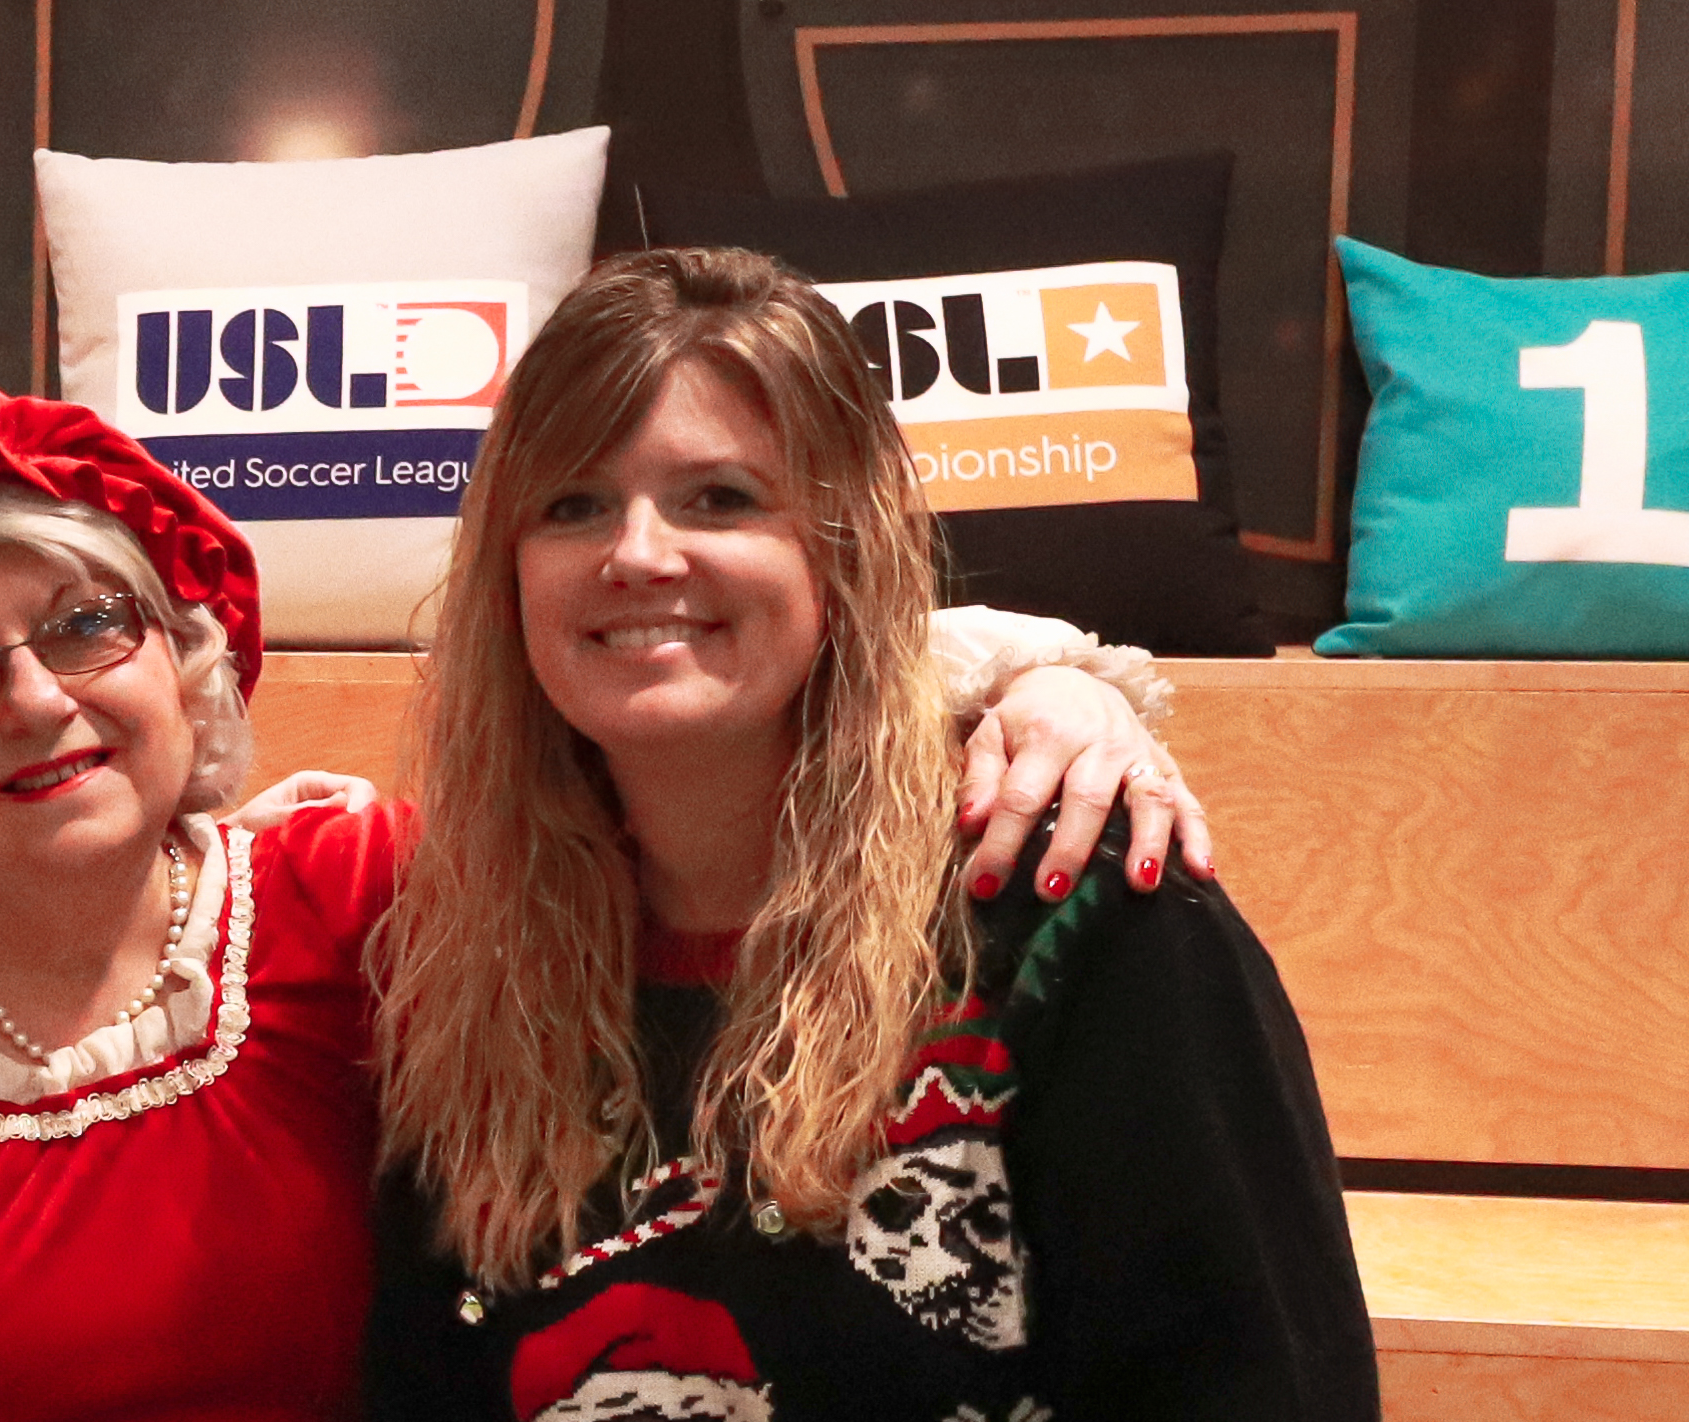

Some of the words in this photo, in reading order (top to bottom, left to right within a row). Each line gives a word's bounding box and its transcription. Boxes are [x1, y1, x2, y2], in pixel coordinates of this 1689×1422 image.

[136, 304, 387, 415] USL
[850, 293, 1040, 402] SL
[244, 457, 367, 488] Soccer
[1505, 319, 1689, 567] 1
